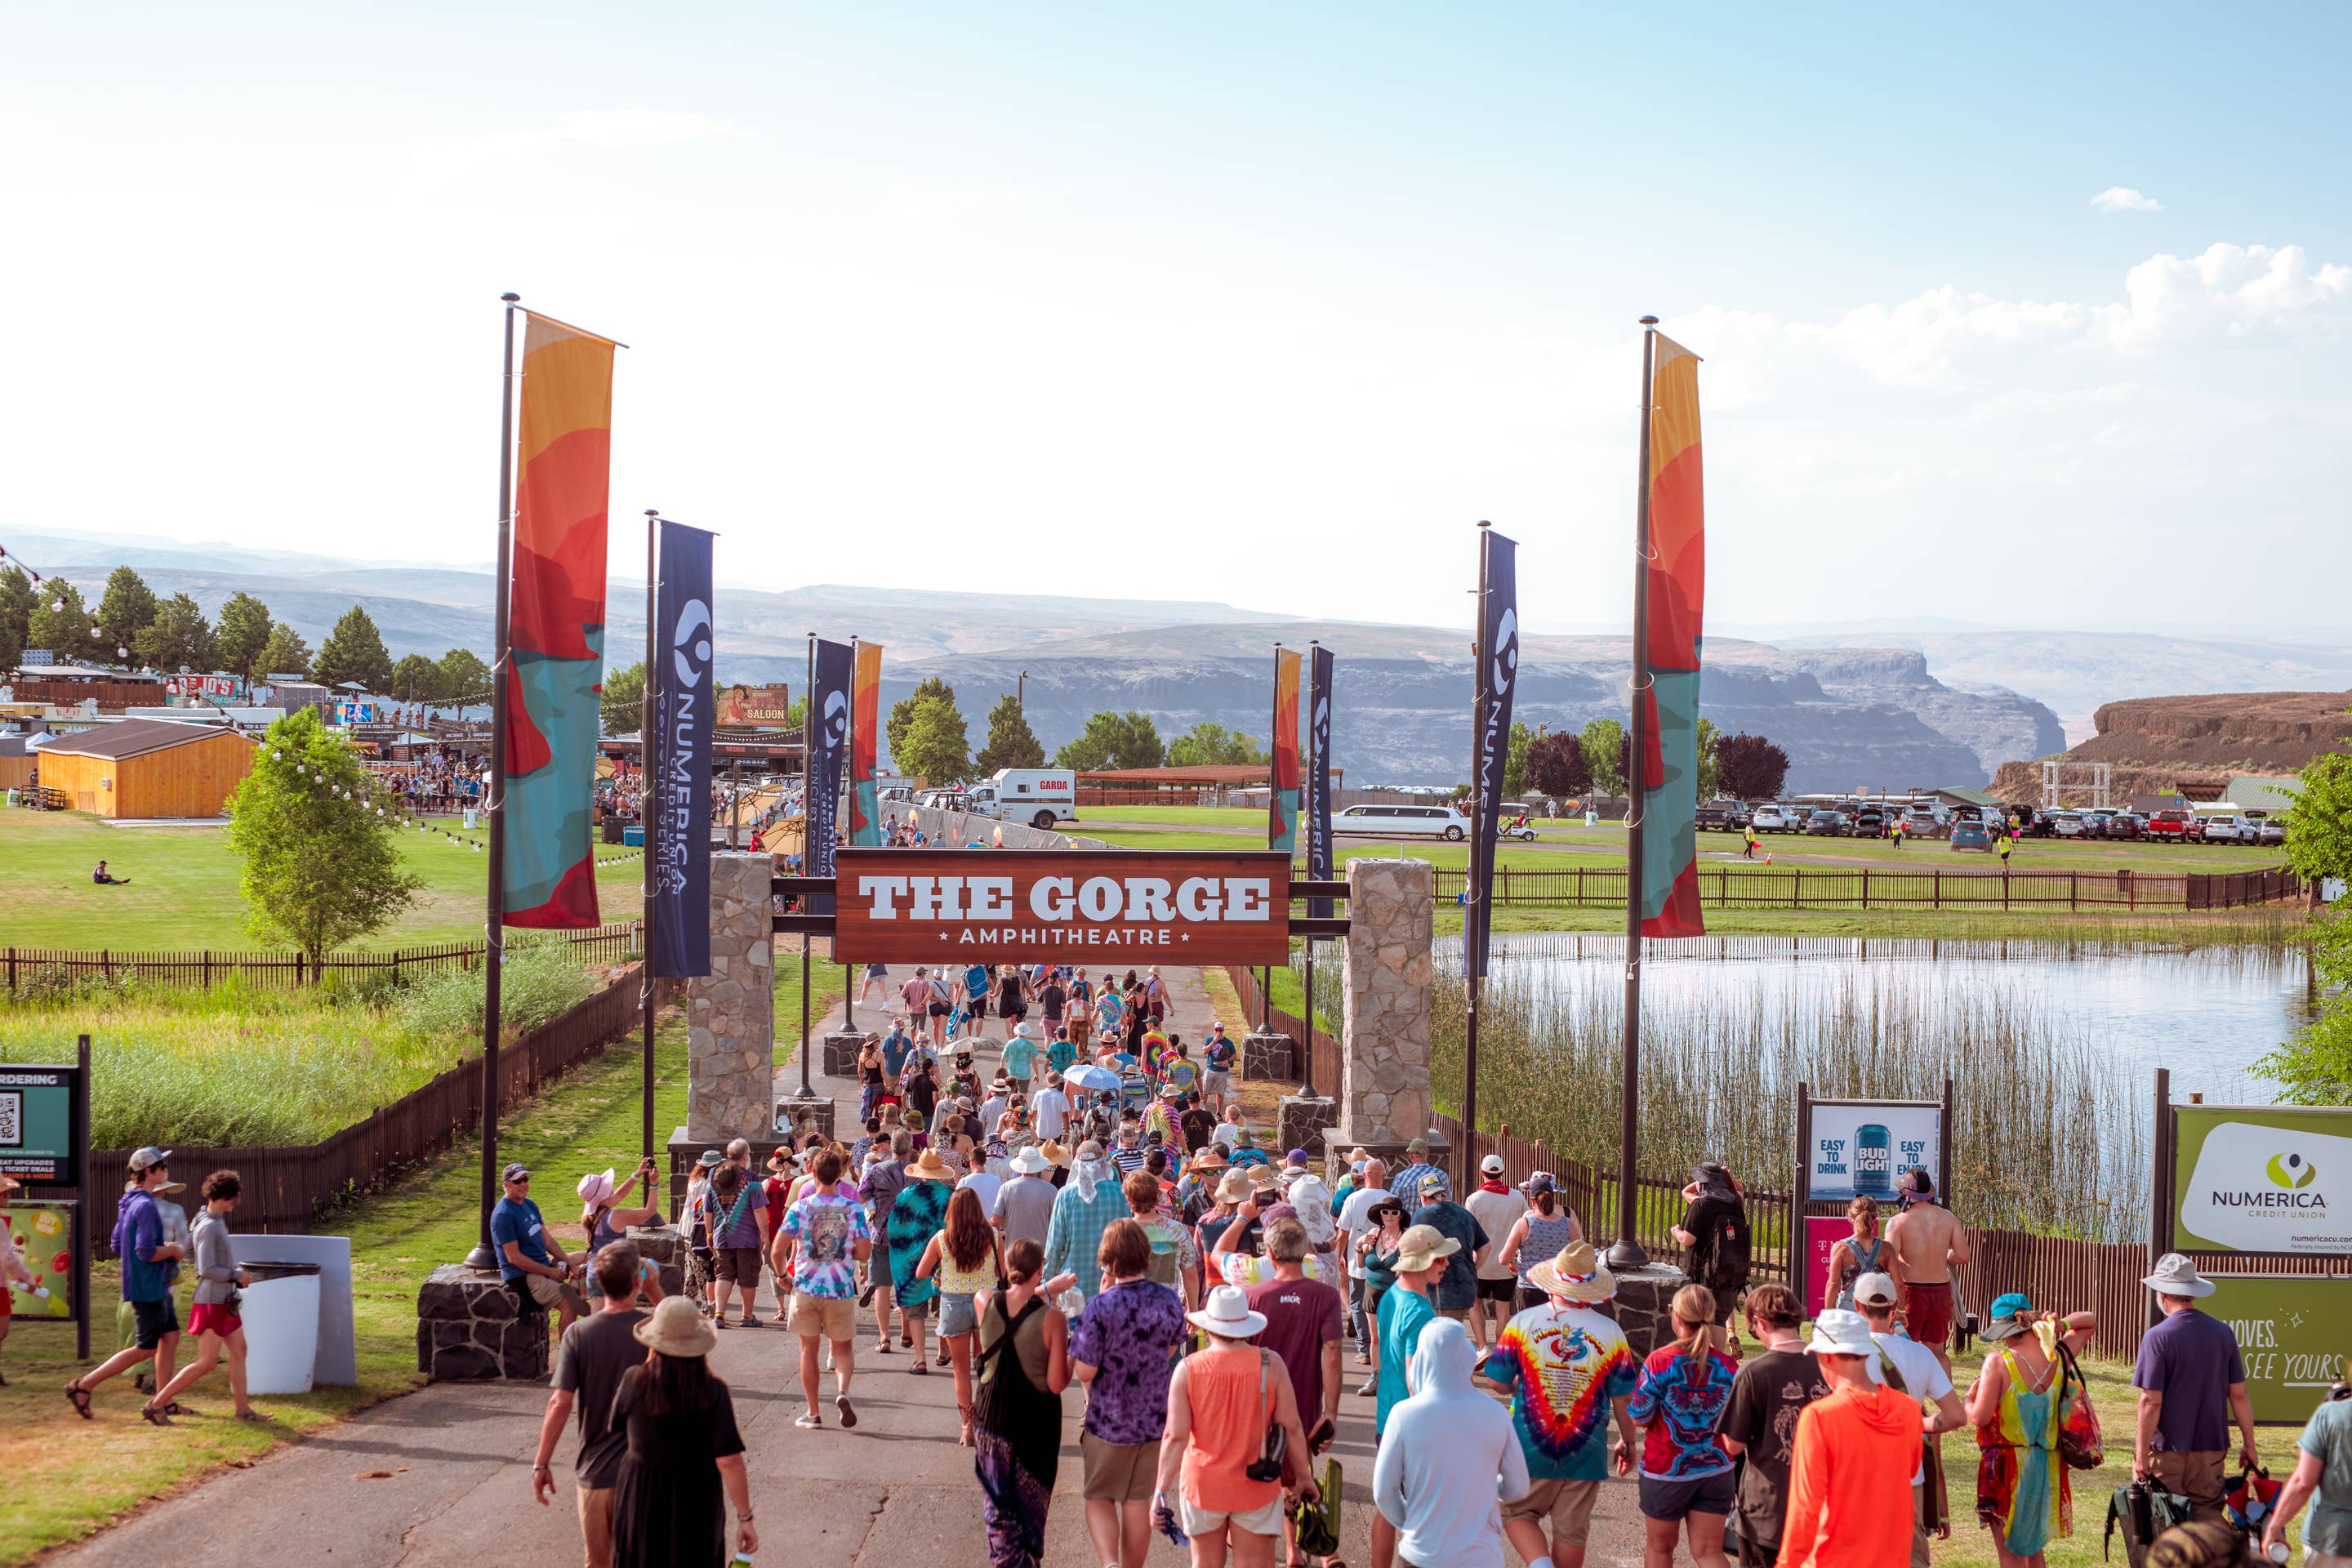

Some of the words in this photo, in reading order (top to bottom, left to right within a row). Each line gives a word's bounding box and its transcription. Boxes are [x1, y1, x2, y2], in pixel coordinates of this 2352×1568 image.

[747, 709, 784, 719] SALOON
[668, 757, 677, 823] CREDIT
[1040, 780, 1067, 790] GARDA
[675, 693, 695, 895] NUMERICA
[669, 833, 679, 895] UNION
[859, 875, 1013, 920] THE
[1030, 875, 1270, 922] GORGE
[959, 928, 1171, 945] AMPHITHEATRE
[1820, 1139, 1846, 1151] EASY
[1900, 1141, 1925, 1152] EASY
[1826, 1152, 1838, 1162] TO
[1859, 1147, 1888, 1160] BUD
[1907, 1153, 1918, 1164] TO
[1818, 1163, 1846, 1174] DRINK
[1855, 1160, 1890, 1171] LIGHT
[2212, 1191, 2326, 1208] NUMERICA
[1534, 1327, 1561, 1343] FINAL
[2244, 1353, 2278, 1379] SEE
